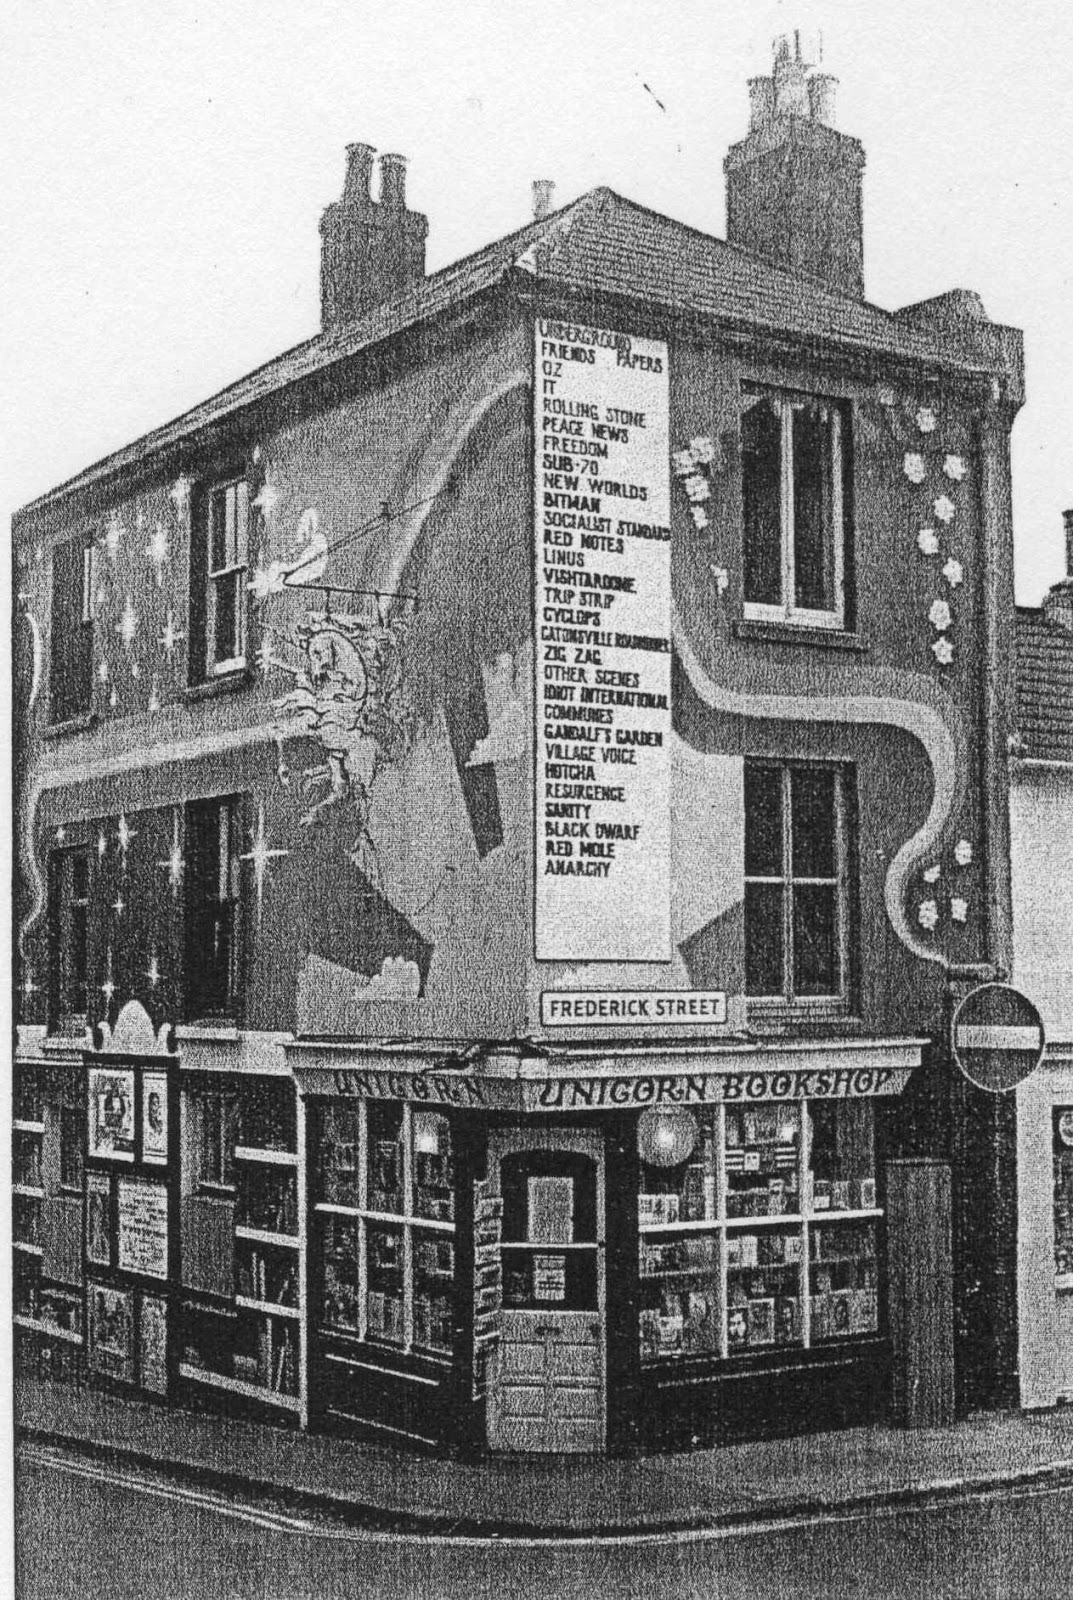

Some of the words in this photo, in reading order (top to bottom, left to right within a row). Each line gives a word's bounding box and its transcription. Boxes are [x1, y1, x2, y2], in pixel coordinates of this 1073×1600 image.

[539, 320, 633, 350] UNDERGROUND
[541, 341, 596, 364] FRIENDS
[616, 351, 663, 373] PAPERS
[542, 360, 562, 377] OZ
[543, 379, 557, 395] IT
[543, 397, 599, 421] ROLLING
[605, 408, 647, 428] STONE
[543, 416, 585, 436] PEACE
[591, 423, 629, 443] NEWS
[543, 435, 608, 459] FREEDOM
[543, 472, 579, 491] NEW
[588, 479, 648, 501] WORLDS
[543, 492, 601, 513] BITMAN
[543, 511, 612, 534] SOCIALIST
[543, 529, 573, 547] RED
[581, 533, 624, 554] NOTES
[543, 548, 585, 567] LINUS
[544, 587, 575, 605] TRIP
[579, 591, 615, 609] STRIP
[543, 607, 601, 626] CYCLOPS
[544, 645, 567, 662] ZIG
[574, 647, 602, 665] ZAG
[544, 664, 588, 684] OTHER
[595, 669, 640, 688] SCENES
[544, 684, 576, 702] IDIOT
[580, 686, 669, 710] INTERNATIONAL
[544, 703, 614, 725] COMMUNES
[615, 728, 663, 747] GARDEN
[545, 743, 596, 762] VILLAGE
[601, 747, 637, 765] VOICE
[545, 762, 596, 781] HOTCHA
[545, 782, 626, 802] RESURGENCE
[545, 802, 592, 819] SANITY
[545, 821, 590, 838] BLACK
[595, 823, 640, 840] DWARF
[545, 840, 573, 857] RED
[579, 841, 615, 859] MOLE
[544, 859, 611, 878] ANARCHY
[551, 999, 649, 1017] FREDERICK
[656, 999, 720, 1016] STREET
[539, 1076, 707, 1107] UNICORN
[723, 1069, 892, 1099] BOOKSHOP
